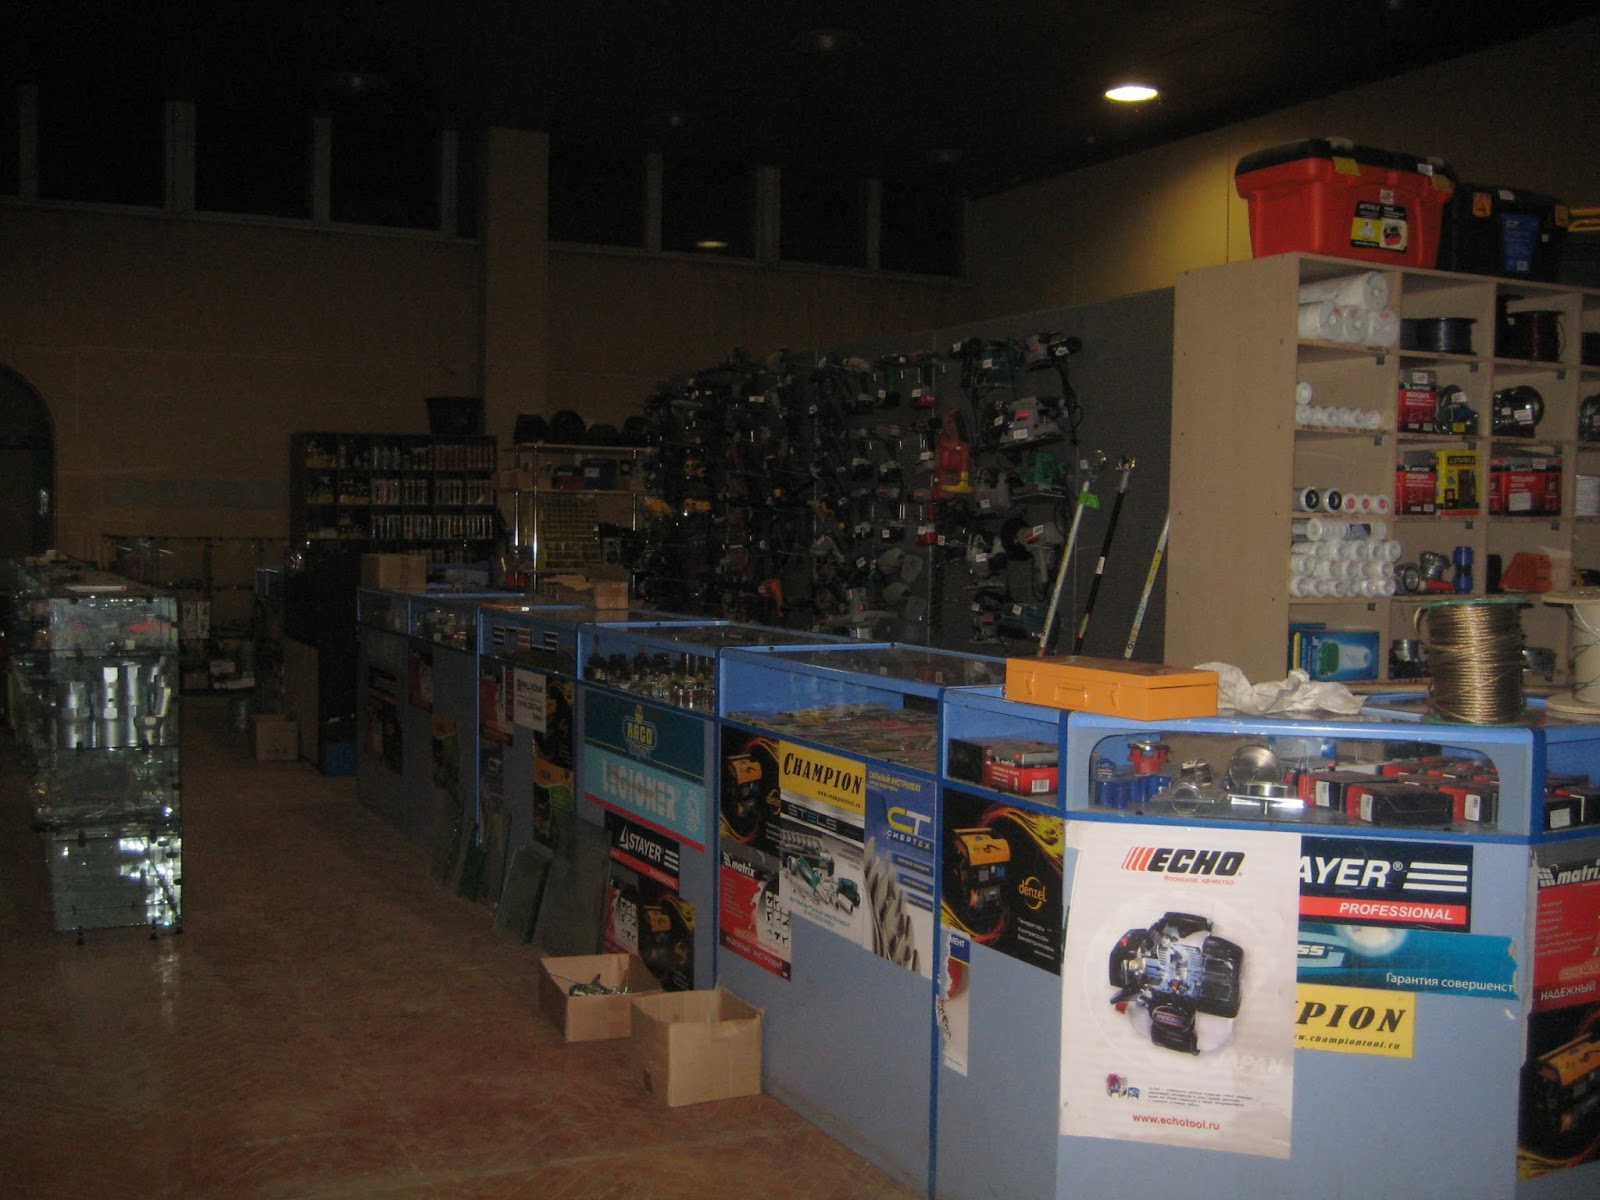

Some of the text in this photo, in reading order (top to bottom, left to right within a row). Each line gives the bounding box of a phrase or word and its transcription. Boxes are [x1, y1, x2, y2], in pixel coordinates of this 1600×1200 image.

[783, 752, 863, 796] CHAMPION
[788, 803, 837, 831] STELS
[629, 832, 661, 863] STAYER
[886, 830, 931, 850] СИБРТЕХ
[731, 859, 756, 878] matrix
[1147, 848, 1245, 876] ECHO
[1018, 877, 1047, 902] denzel
[1339, 902, 1454, 921] PROFESSIONAL
[1386, 973, 1438, 987] Гарантия
[1540, 981, 1596, 1001] НАДЕЖНЫЙ
[1296, 1001, 1406, 1033] PION
[1295, 1034, 1400, 1050] w.championtool.ru
[1132, 1113, 1220, 1131] www.echotool.ru
